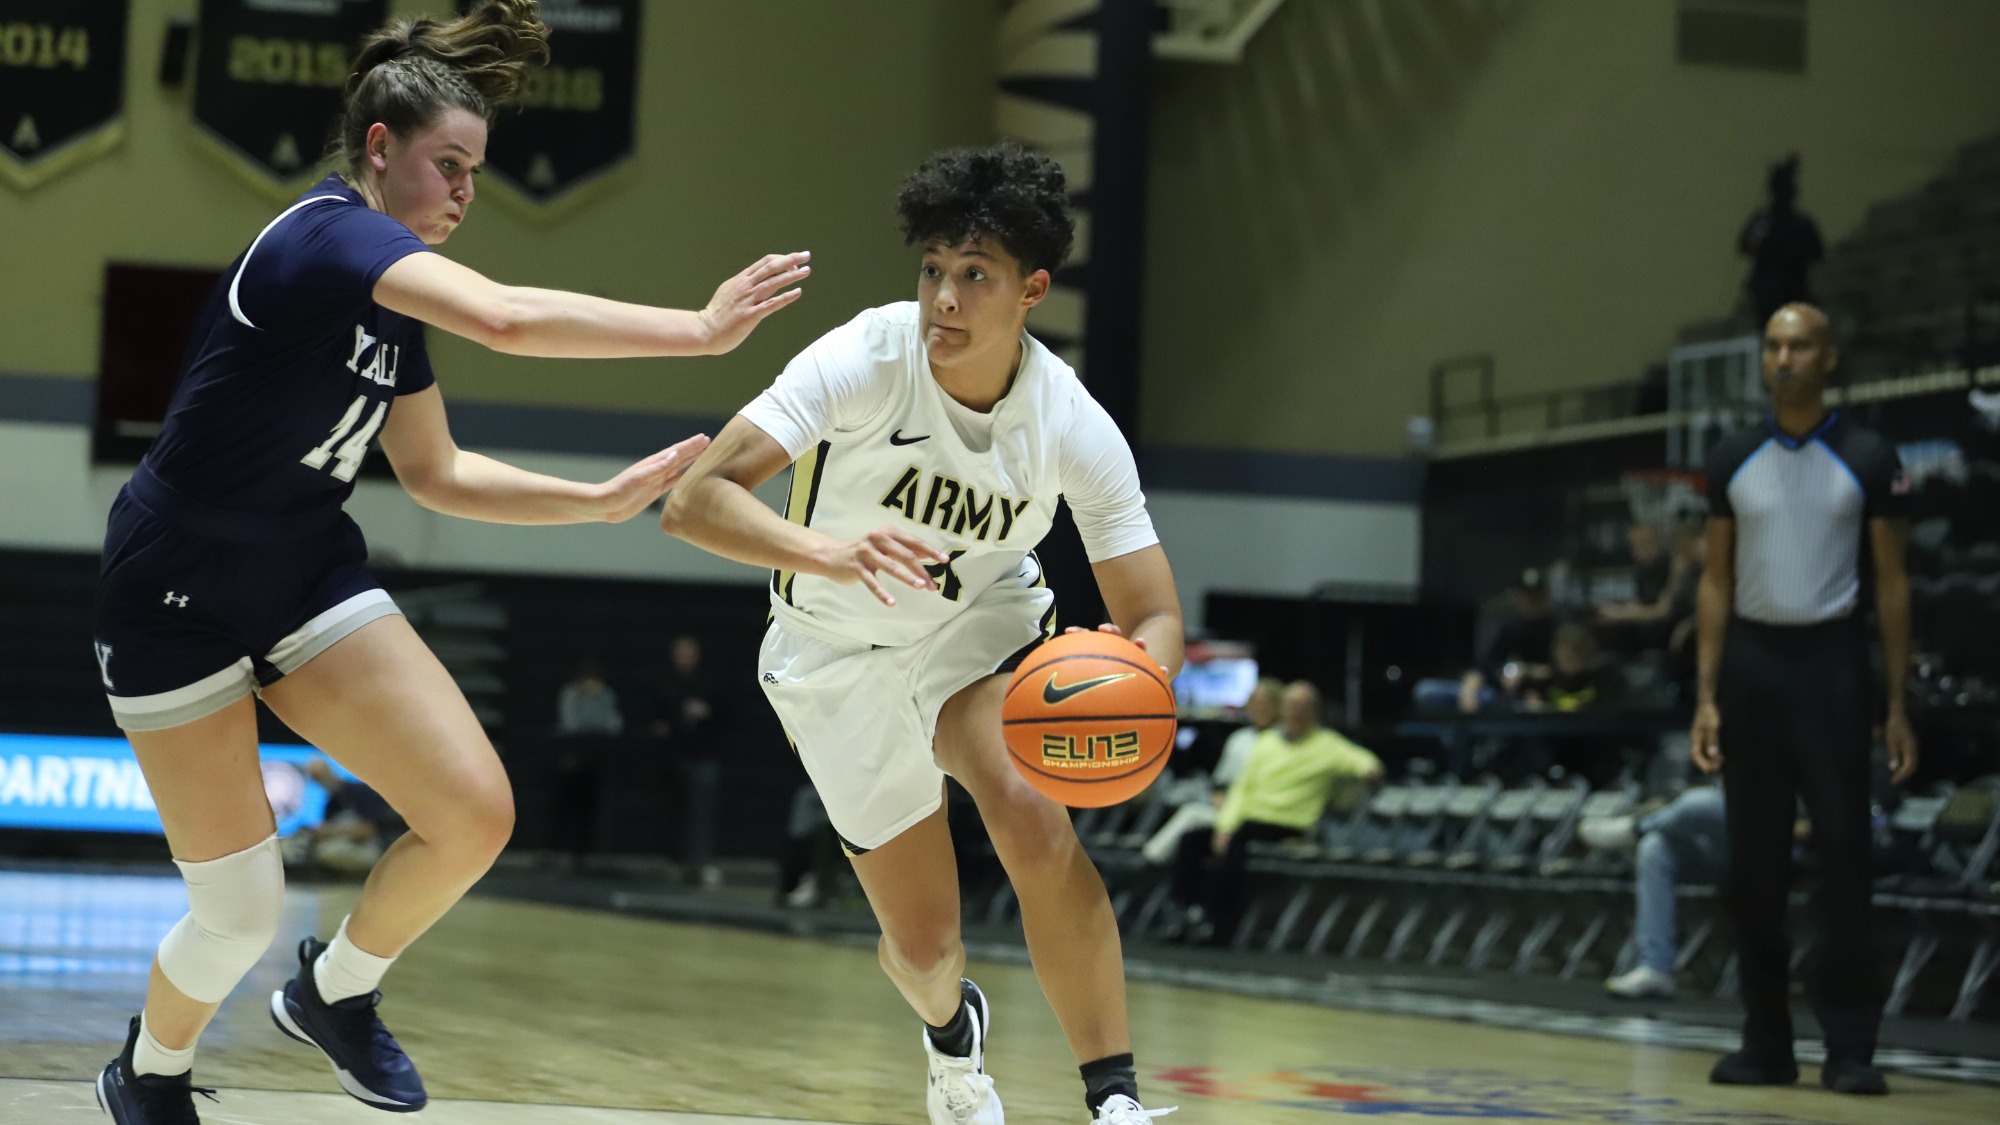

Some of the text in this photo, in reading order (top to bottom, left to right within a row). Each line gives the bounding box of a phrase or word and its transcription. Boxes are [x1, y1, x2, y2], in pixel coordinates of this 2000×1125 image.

[0, 22, 88, 70] 014
[300, 394, 388, 483] 14
[878, 464, 1034, 543] ARMY
[1042, 729, 1139, 761] ELITE
[1042, 755, 1139, 769] CHAMPIONSHIP
